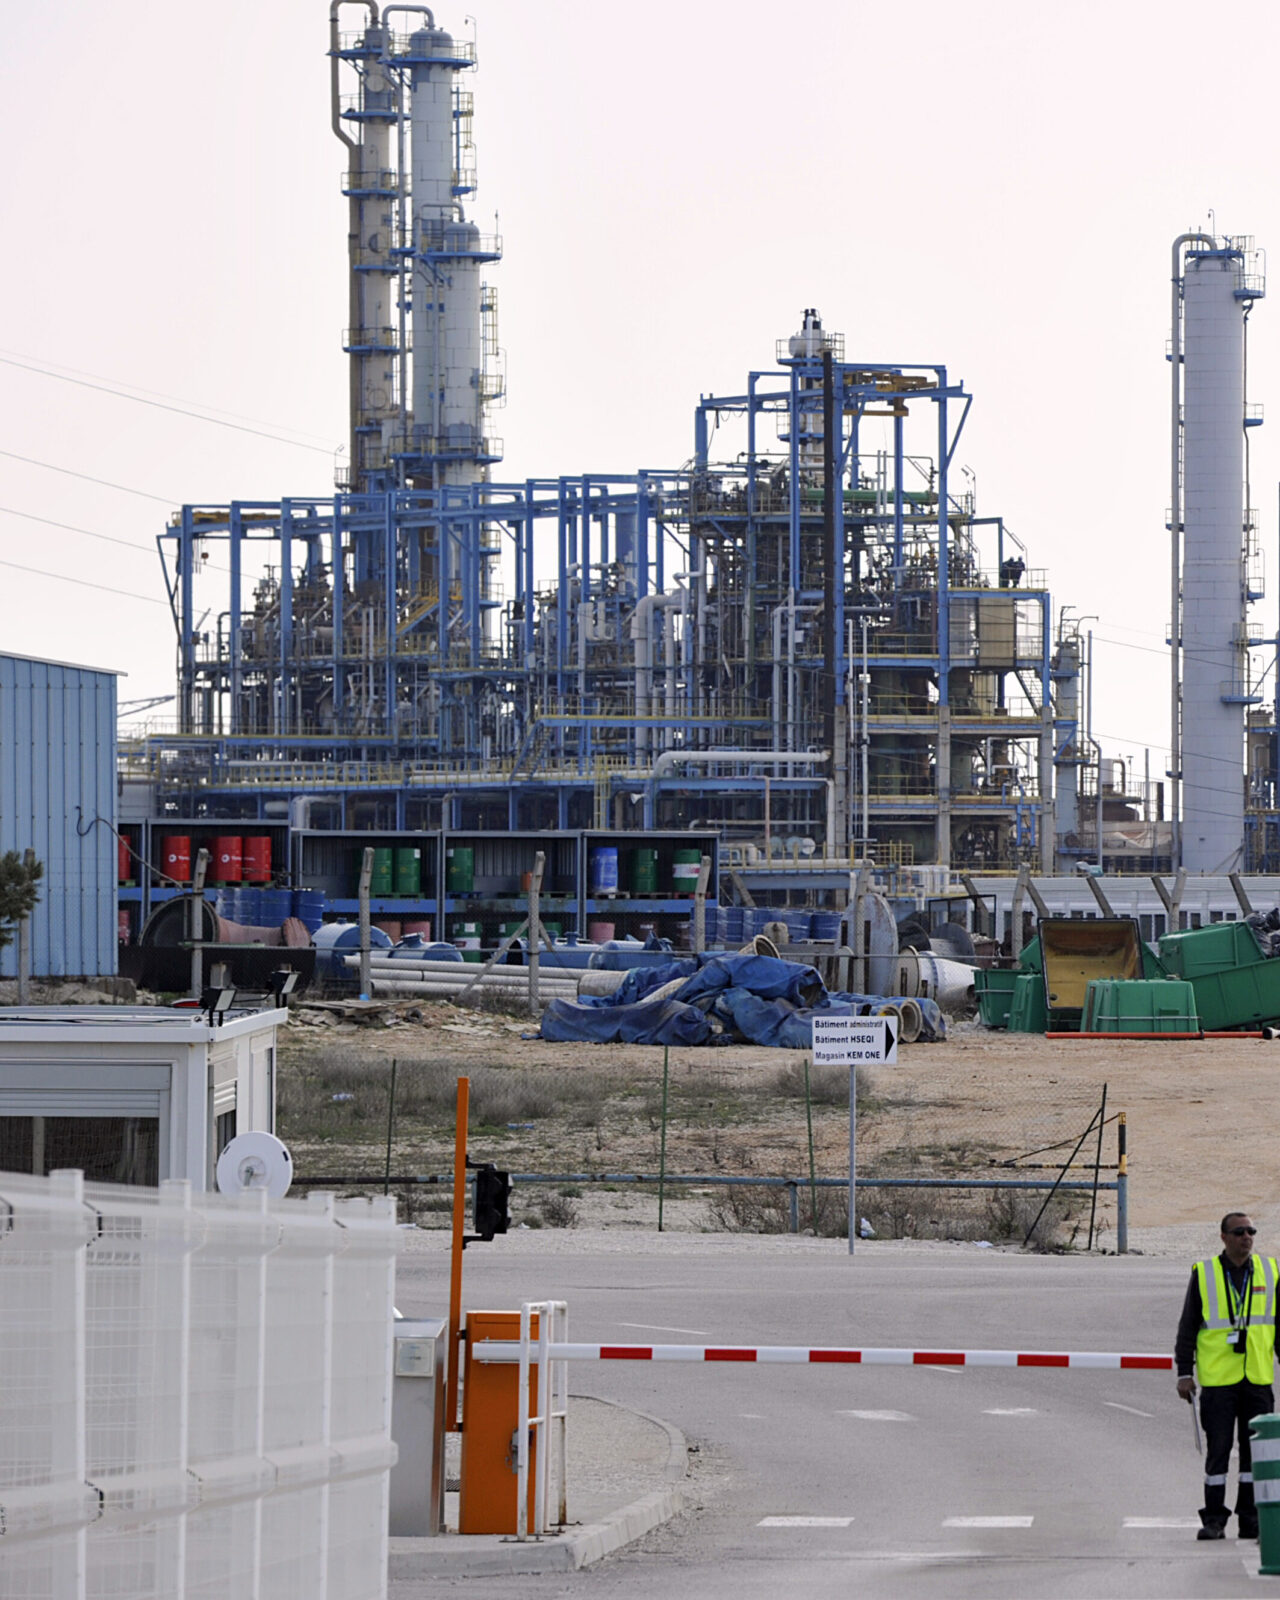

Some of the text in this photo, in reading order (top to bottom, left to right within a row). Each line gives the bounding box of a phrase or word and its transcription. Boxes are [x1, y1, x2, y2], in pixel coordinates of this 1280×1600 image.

[849, 1020, 883, 1028] administratif
[850, 1035, 874, 1043] HSEQI
[815, 1051, 881, 1061] Magasin KEM ONE
